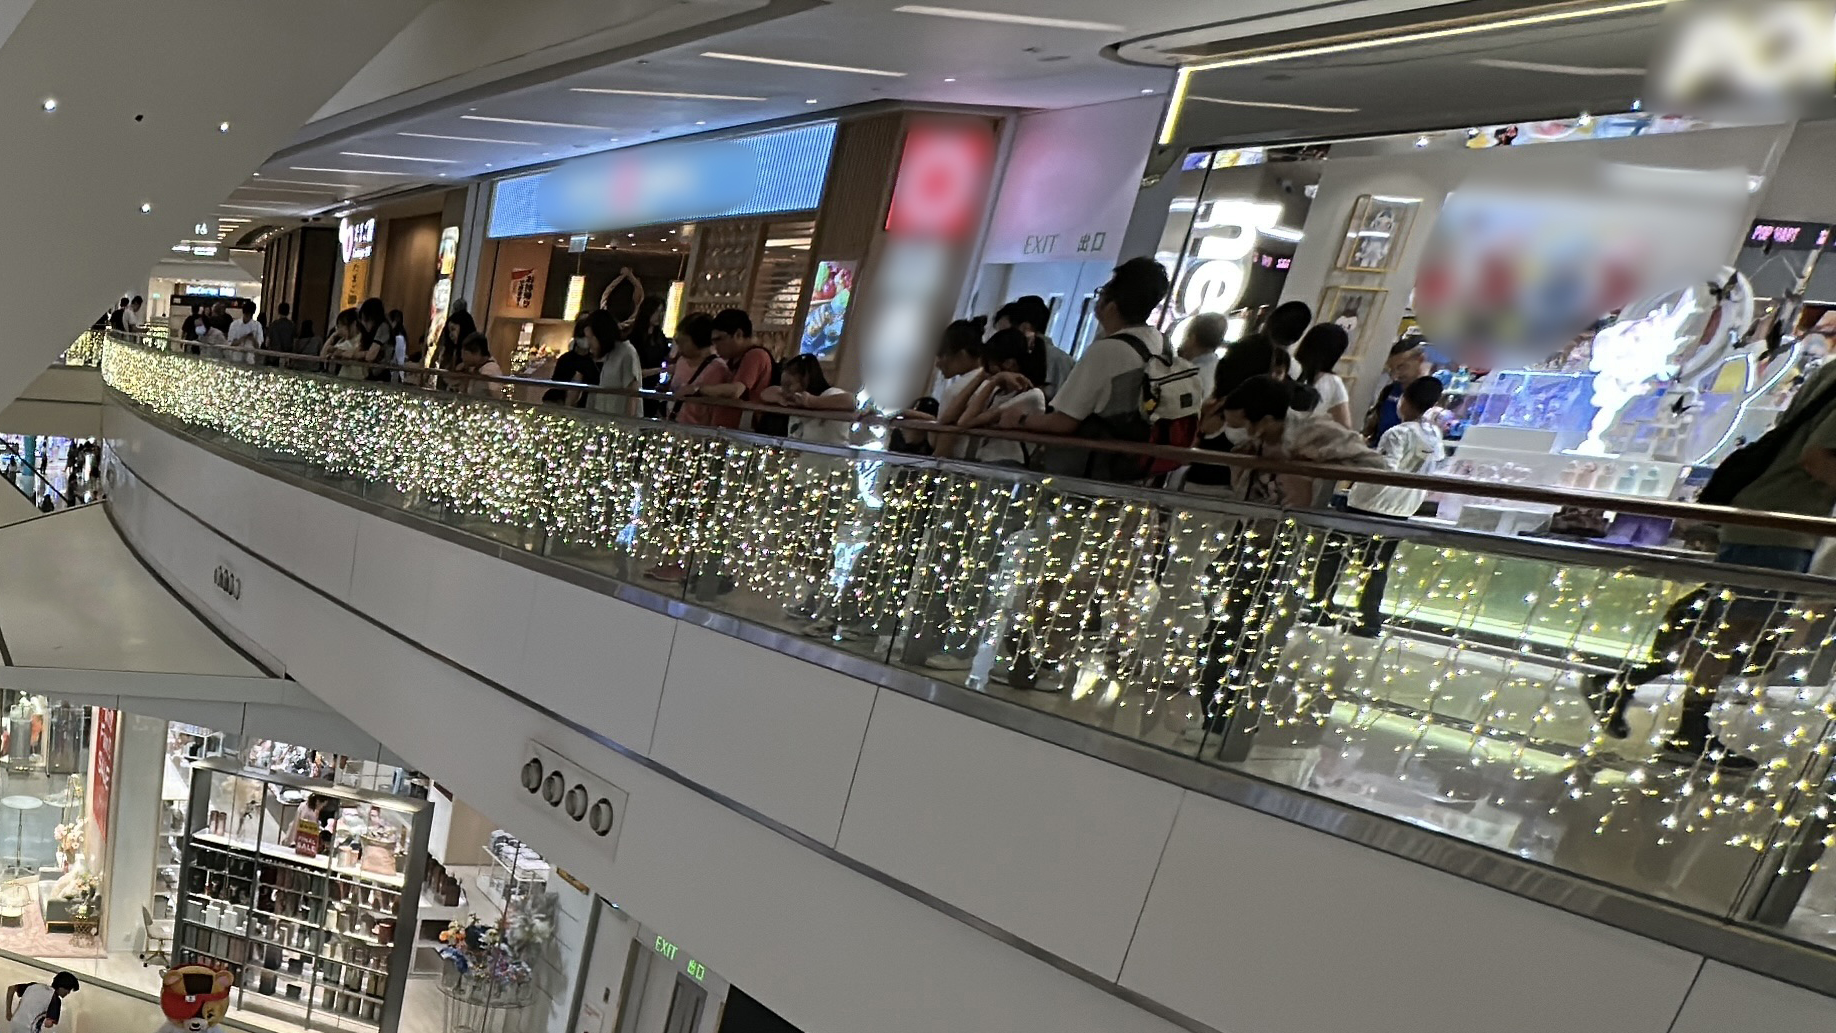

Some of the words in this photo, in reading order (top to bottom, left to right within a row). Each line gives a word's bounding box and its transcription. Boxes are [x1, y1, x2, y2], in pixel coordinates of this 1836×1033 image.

[1023, 233, 1060, 255] EXIT
[1077, 231, 1106, 253] 出口
[296, 842, 316, 853] SALE
[654, 935, 678, 960] EXIT
[687, 959, 705, 981] 出口
